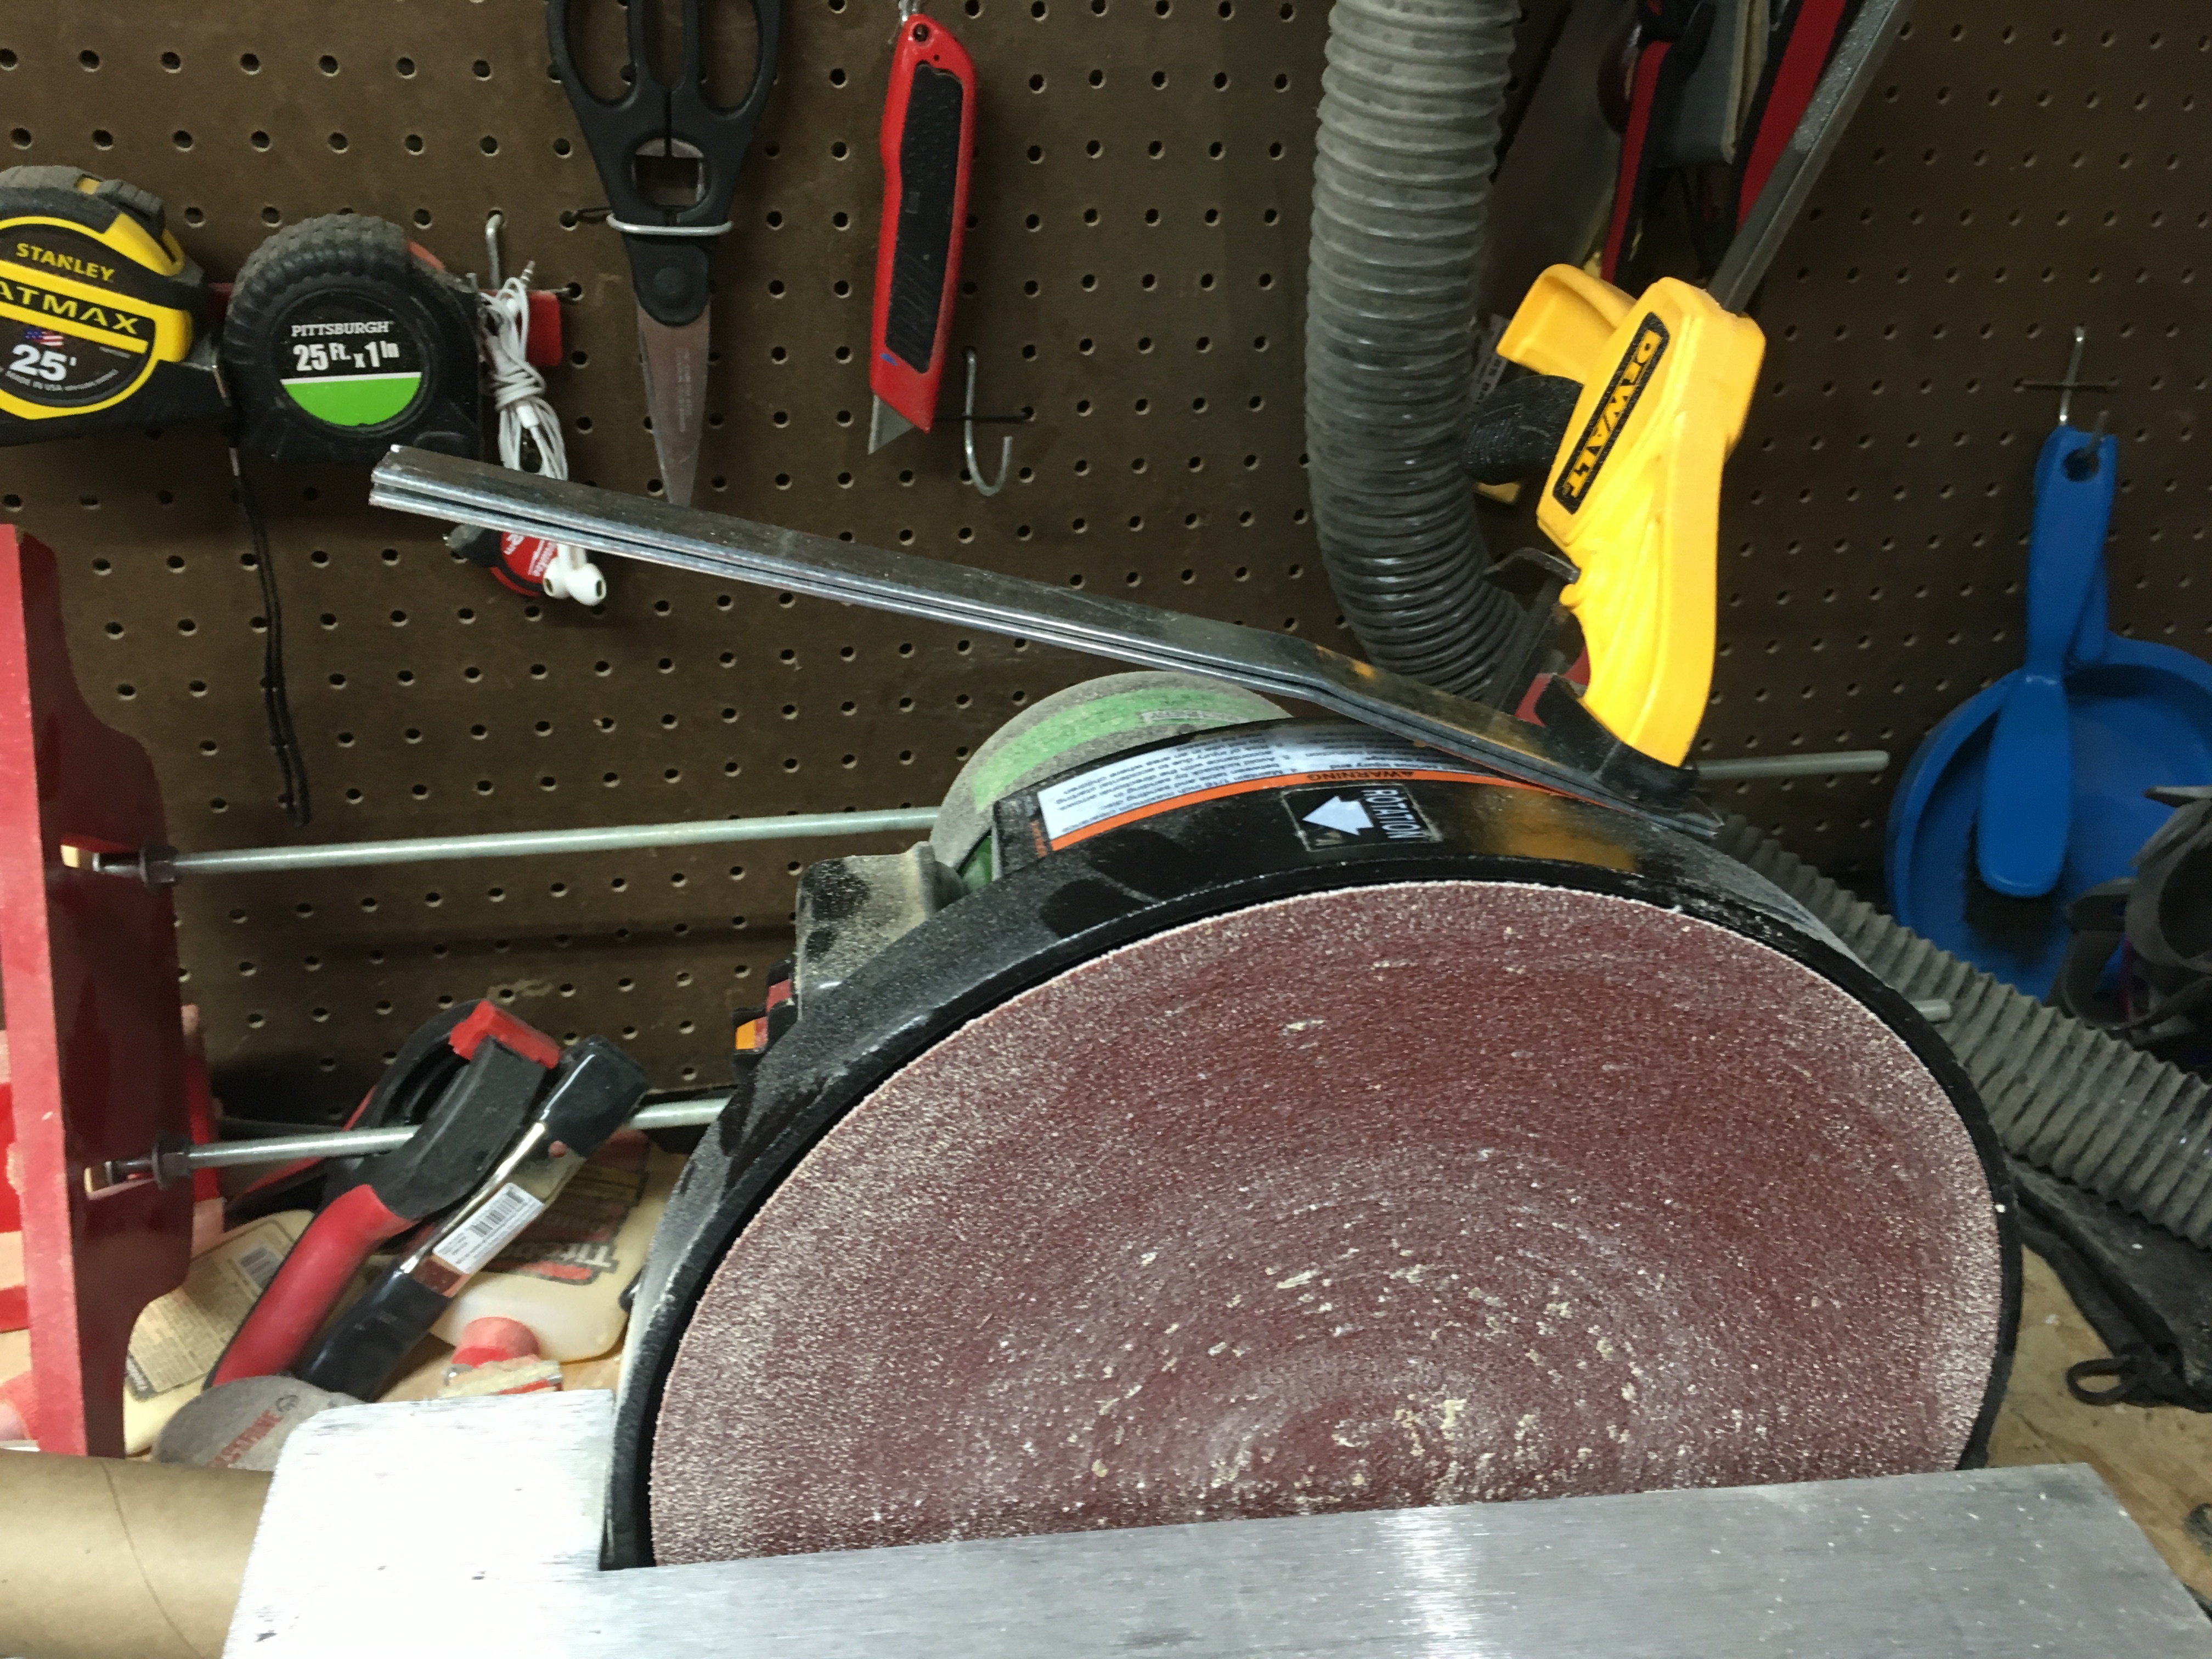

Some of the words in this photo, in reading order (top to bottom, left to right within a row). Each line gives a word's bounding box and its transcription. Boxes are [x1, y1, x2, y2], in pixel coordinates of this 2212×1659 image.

[16, 243, 115, 281] STANLEY
[291, 321, 390, 337] PITTSBURGH
[9, 343, 77, 381] 25'
[353, 353, 366, 368] x
[1561, 329, 1663, 498] DEWALT
[1307, 771, 1402, 781] WARNING
[1361, 789, 1427, 839] ROTATION
